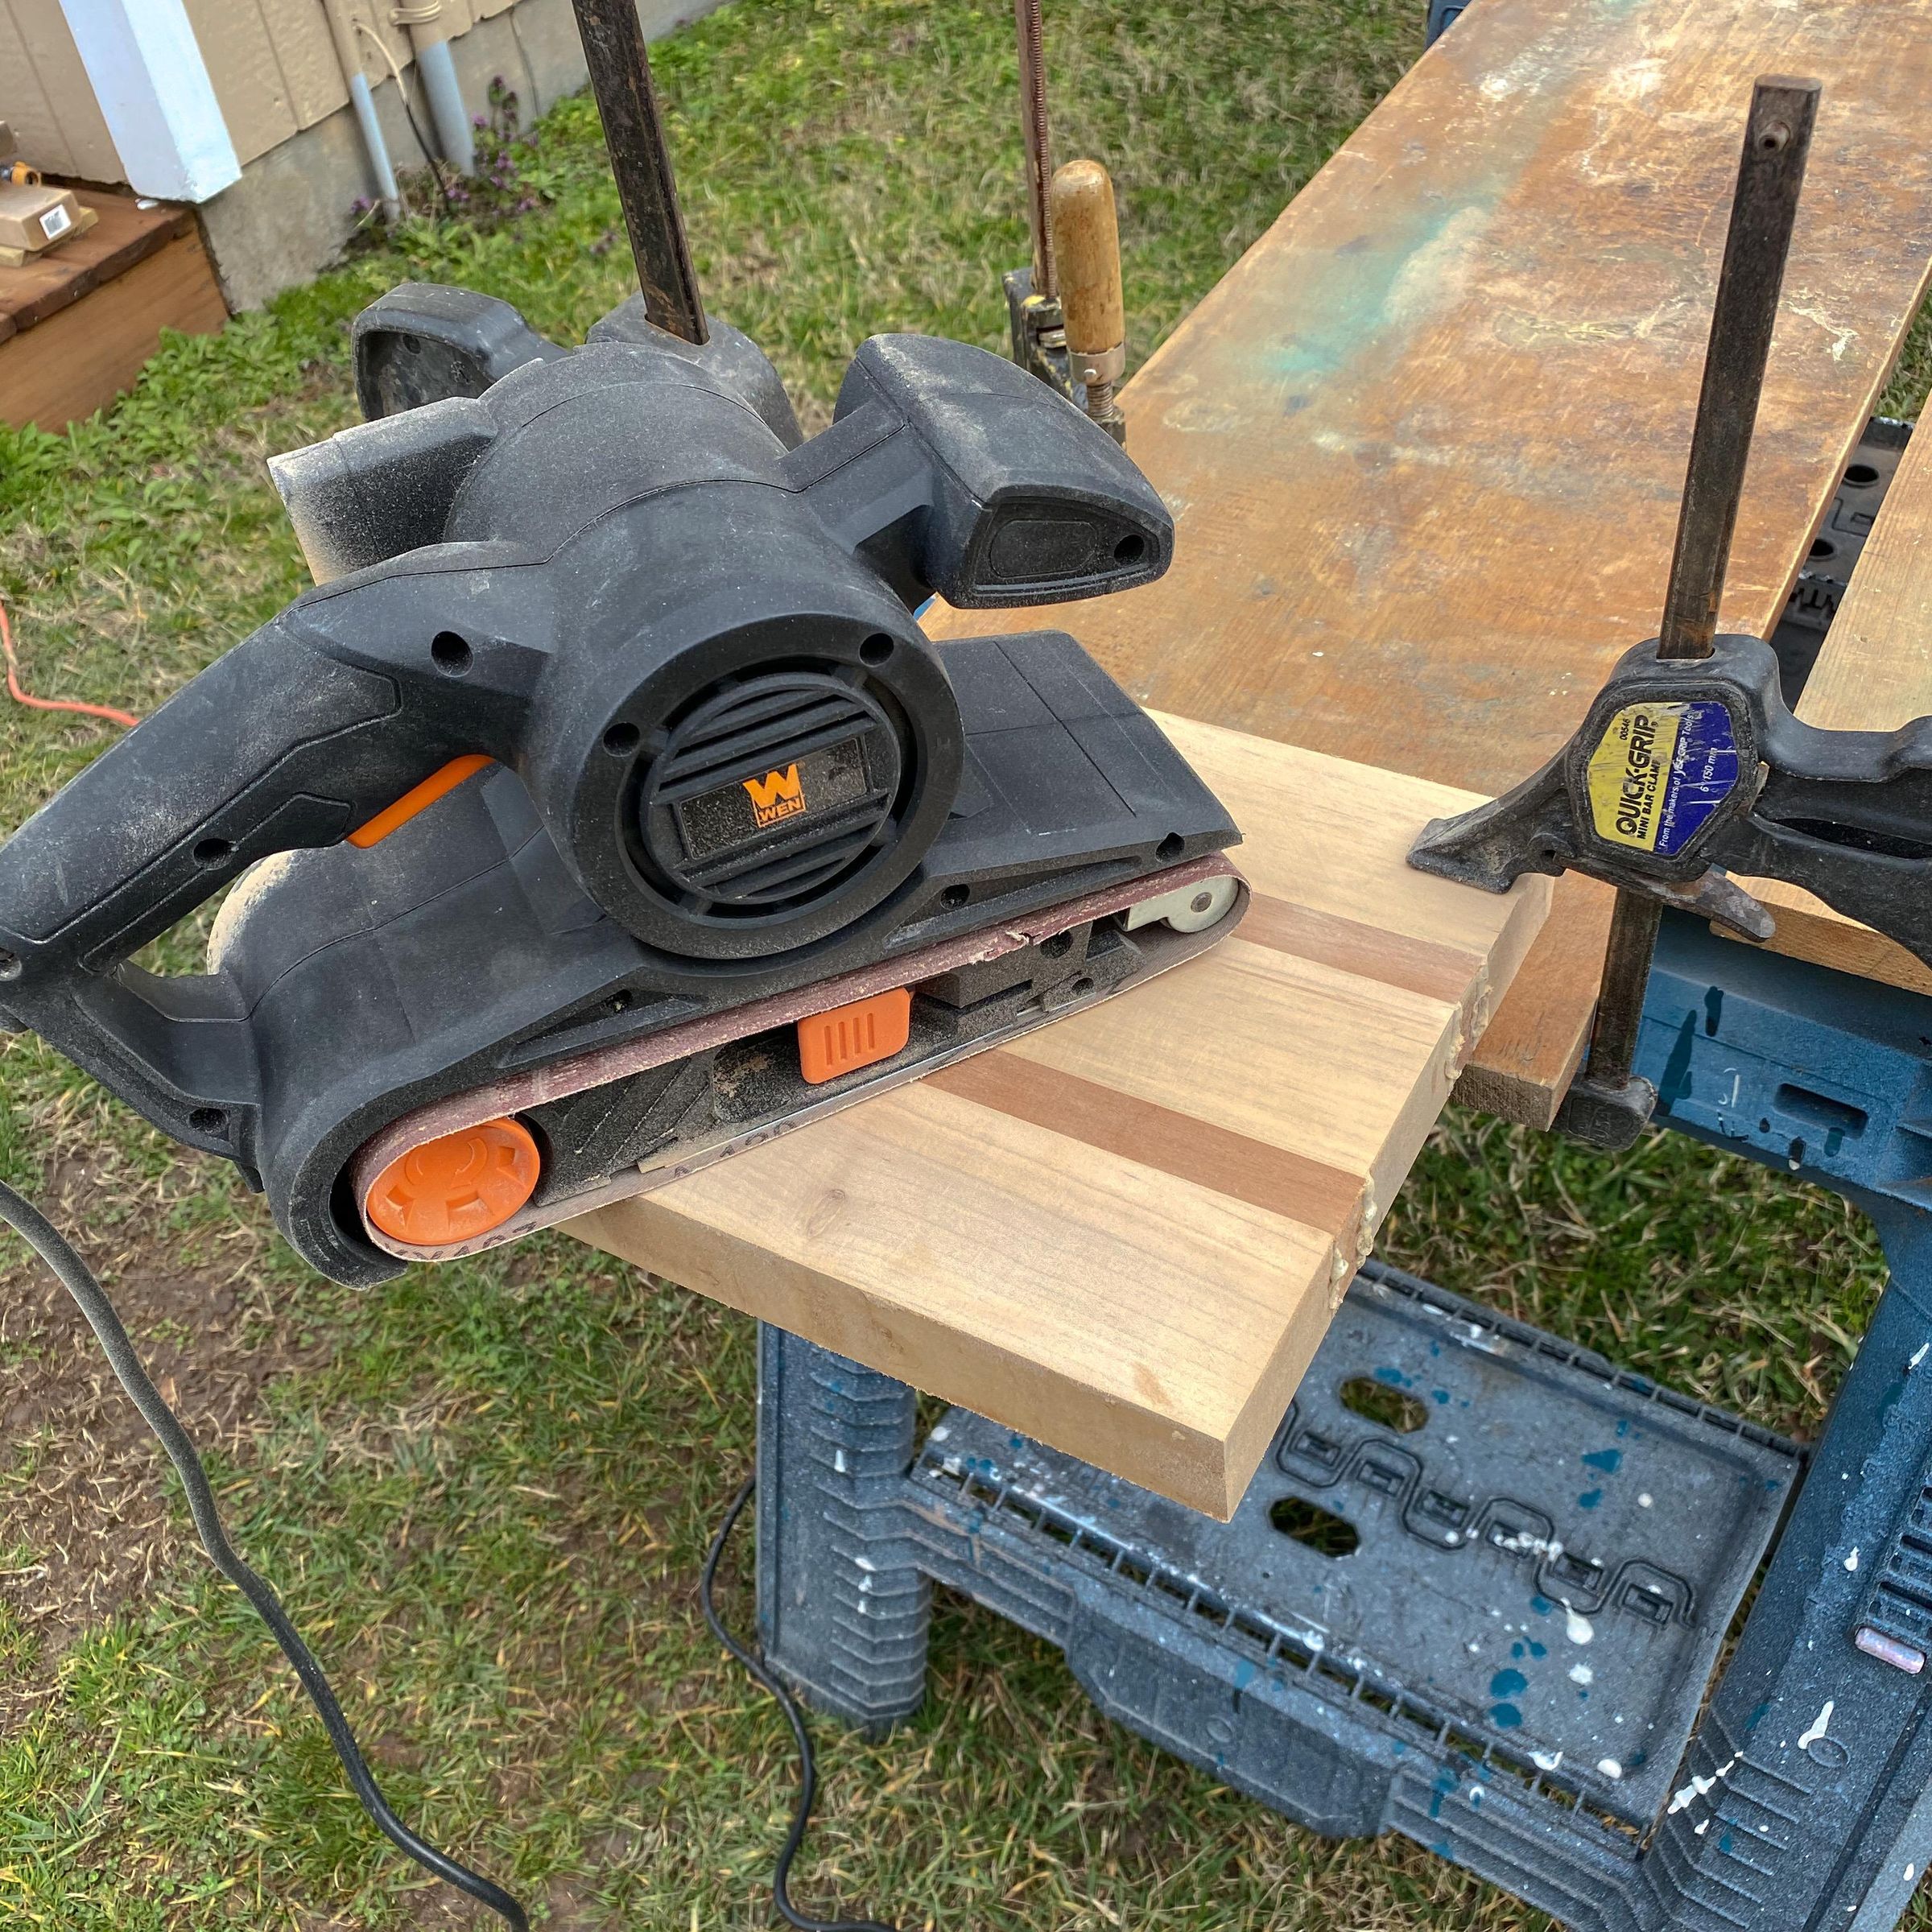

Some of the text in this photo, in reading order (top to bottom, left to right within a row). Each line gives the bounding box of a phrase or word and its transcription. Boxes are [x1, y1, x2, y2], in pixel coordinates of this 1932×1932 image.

[1673, 777, 1681, 786] of
[758, 797, 802, 822] WEN
[1643, 794, 1655, 815] BAR
[1668, 786, 1680, 815] makers
[1637, 816, 1650, 840] MINI
[1665, 815, 1674, 828] the
[1659, 828, 1670, 848] From
